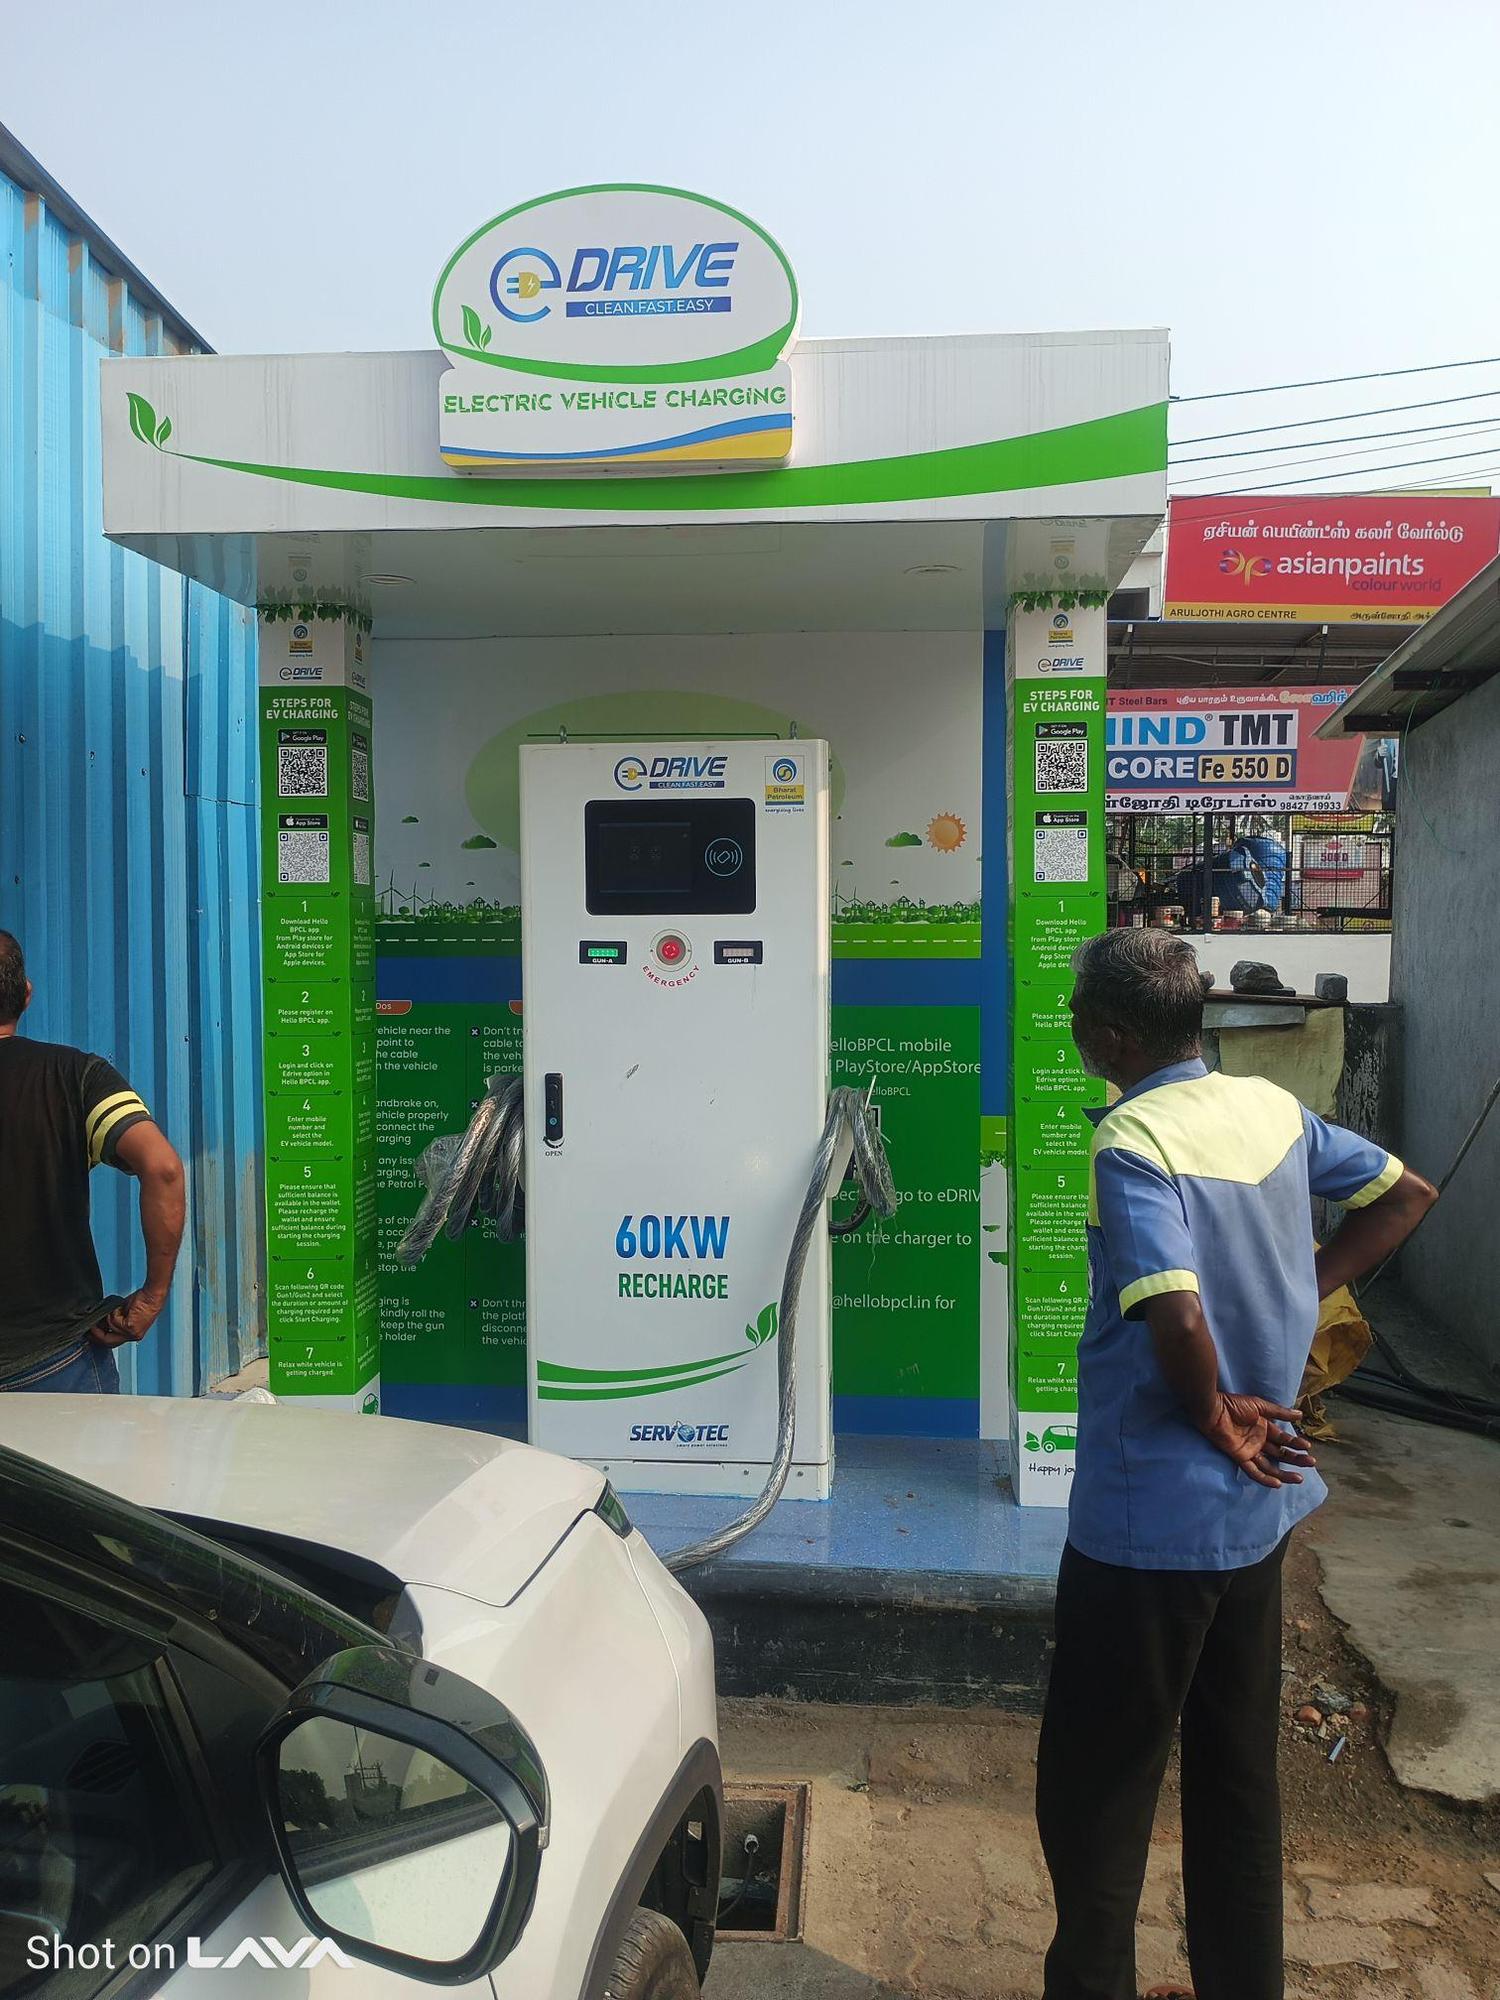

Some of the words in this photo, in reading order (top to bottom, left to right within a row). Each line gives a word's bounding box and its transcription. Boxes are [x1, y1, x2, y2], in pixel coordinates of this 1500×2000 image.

[585, 298, 714, 316] CLEAN.FAST.EASY
[444, 393, 553, 413] ELECTRIC
[560, 390, 656, 410] VEHICLE
[666, 386, 786, 408] CHARGING
[1203, 520, 1259, 542] ஏசியன்
[1355, 520, 1393, 540] கலர்
[1277, 551, 1424, 585] asianpaints
[1351, 577, 1398, 592] colour
[1400, 578, 1442, 592] world
[1169, 609, 1225, 619] ARULJOTHI
[1226, 610, 1256, 619] AGRO
[1257, 610, 1298, 620] CENTRE
[1030, 690, 1067, 701] STEPS
[1070, 690, 1093, 700] FOR
[1118, 697, 1143, 706] Steel
[1145, 696, 1168, 705] Bars
[272, 698, 308, 708] STEPS
[310, 698, 331, 708] FOR
[1023, 703, 1038, 713] EV
[1041, 701, 1100, 712] CHARGING
[266, 710, 281, 719] EV
[283, 709, 339, 719] CHARGING
[1050, 728, 1072, 736] Google
[1073, 728, 1084, 736] Play
[1219, 714, 1293, 746] TMT
[293, 735, 311, 743] Google
[312, 735, 324, 743] Play
[1108, 757, 1194, 779] CORE
[1201, 758, 1225, 779] Fe
[1231, 757, 1269, 779] 550
[1276, 757, 1290, 778] D
[1280, 802, 1308, 810] 98427
[1312, 802, 1341, 810] 19933
[301, 900, 307, 913] 1
[1058, 900, 1064, 913] 1
[642, 965, 700, 987] EMERGENCY
[301, 991, 309, 1003] 2
[1057, 995, 1065, 1007] 2
[409, 1027, 432, 1035] near
[435, 1026, 450, 1035] the
[483, 1026, 510, 1036] Don't
[483, 1039, 512, 1048] cable
[900, 1038, 952, 1052] mobile
[302, 1045, 310, 1057] 3
[390, 1050, 418, 1059] cable
[483, 1051, 500, 1061] the
[1057, 1050, 1065, 1062] 3
[384, 1062, 401, 1071] the
[402, 1062, 438, 1071] vehicle
[483, 1064, 492, 1073] is
[303, 1099, 311, 1111] 4
[407, 1111, 449, 1121] properly
[1057, 1106, 1066, 1118] 4
[418, 1122, 435, 1132] the
[378, 1158, 397, 1166] any
[304, 1166, 312, 1178] 5
[388, 1180, 417, 1189] Petrol
[1057, 1175, 1066, 1188] 5
[918, 1190, 933, 1202] to
[615, 1213, 730, 1260] 60KW
[842, 1233, 861, 1244] on
[894, 1231, 951, 1248] charger
[956, 1233, 972, 1245] to
[307, 1267, 314, 1279] 6
[618, 1273, 729, 1299] RECHARGE
[1059, 1280, 1067, 1292] 6
[401, 1297, 410, 1306] is
[482, 1299, 509, 1309] Don't
[935, 1295, 956, 1309] for
[380, 1309, 409, 1321] kindly
[411, 1309, 427, 1318] roll
[429, 1309, 445, 1319] the
[482, 1311, 499, 1321] the
[381, 1321, 404, 1332] keep
[407, 1321, 423, 1330] the
[425, 1322, 445, 1332] gun
[385, 1333, 416, 1342] holder
[482, 1336, 499, 1346] the
[306, 1347, 314, 1359] 7
[1058, 1363, 1065, 1375] 7
[630, 1422, 729, 1442] SERVOTEC
[1028, 1463, 1060, 1475] Happy
